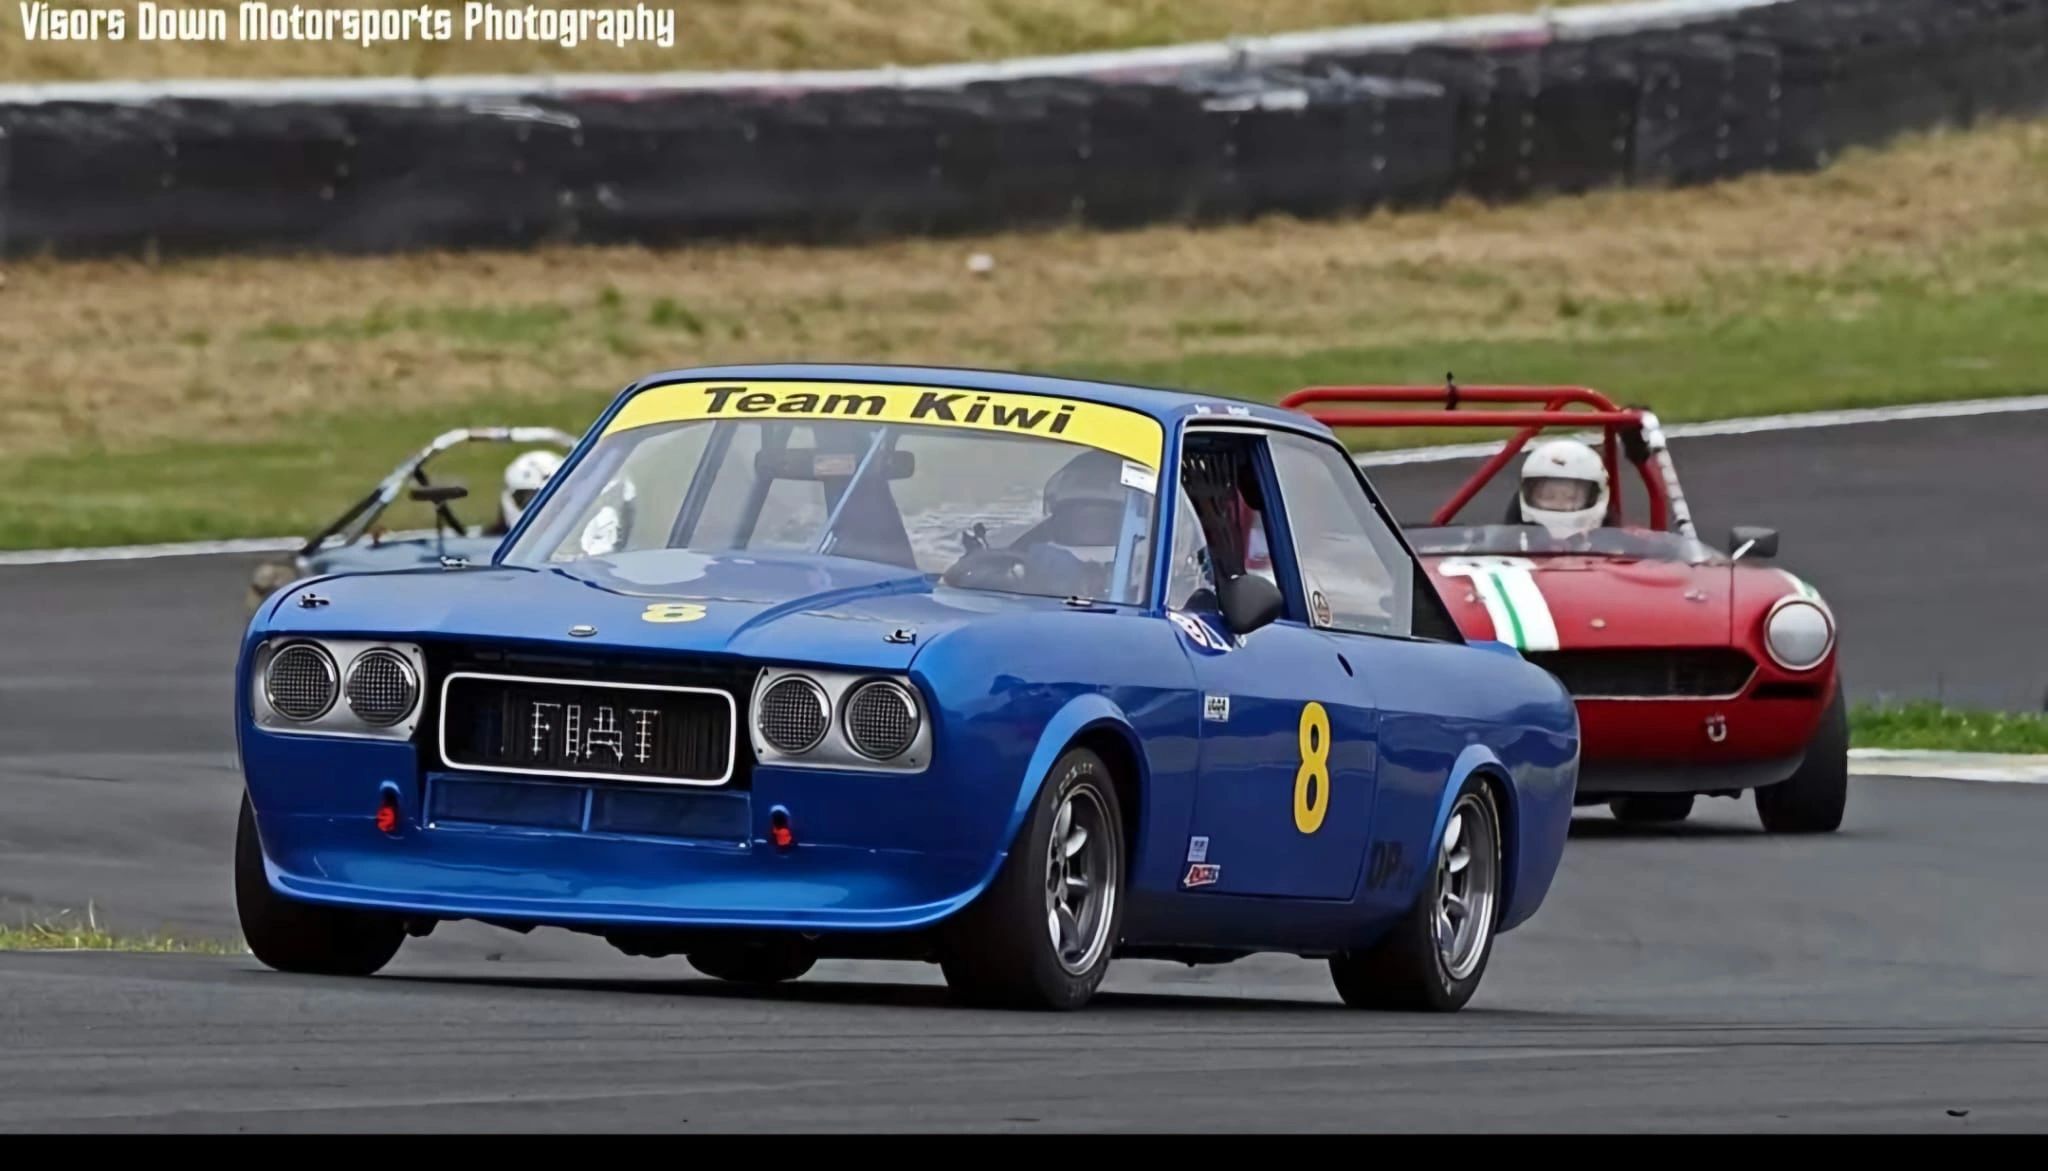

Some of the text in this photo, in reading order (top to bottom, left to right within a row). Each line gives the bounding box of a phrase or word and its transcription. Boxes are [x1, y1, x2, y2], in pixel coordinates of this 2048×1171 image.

[704, 387, 1075, 434] Team Kiwi
[641, 603, 707, 623] 8
[532, 701, 660, 764] FIAT
[1293, 701, 1331, 834] 8
